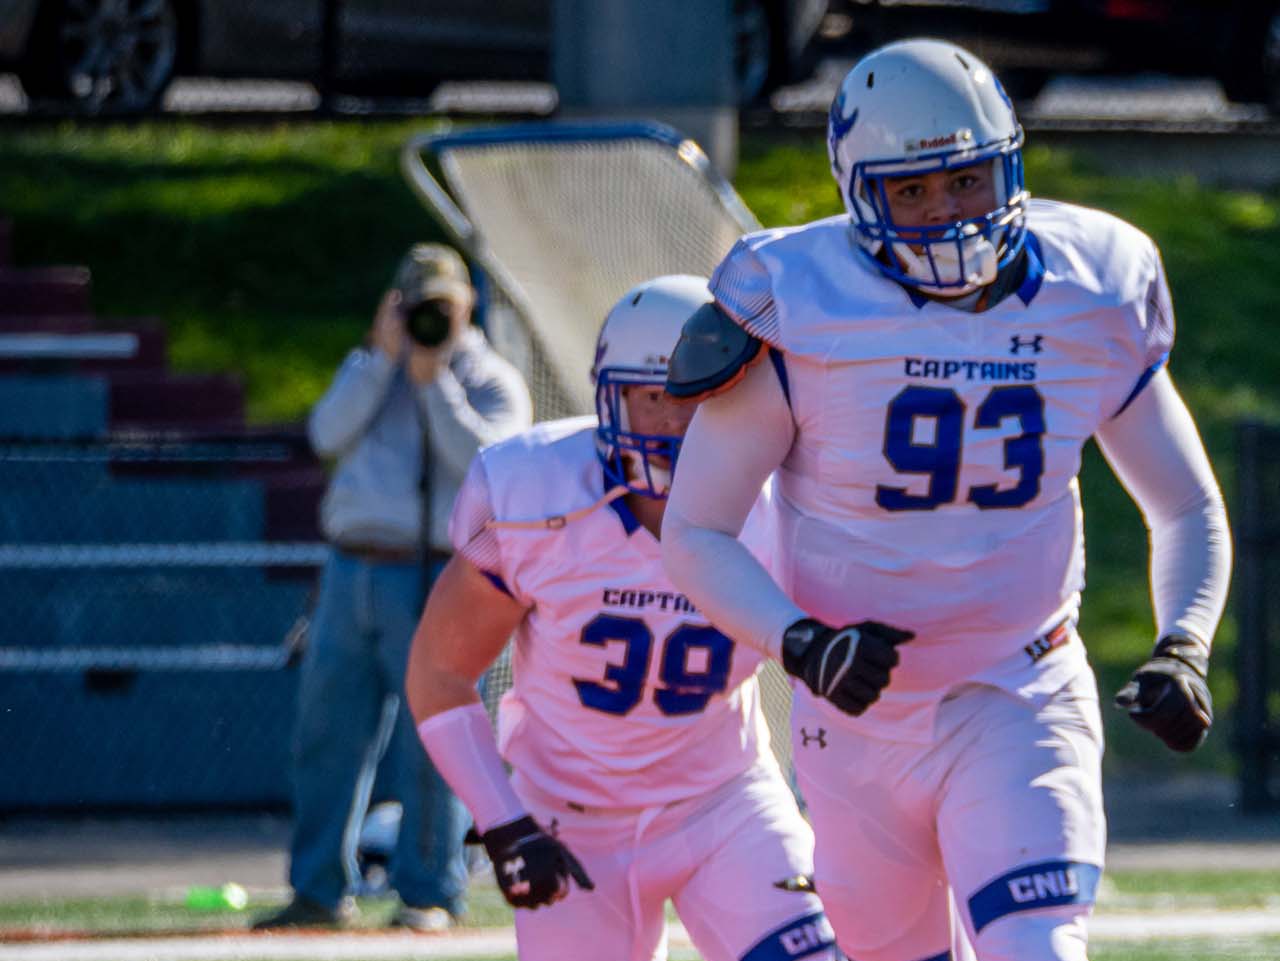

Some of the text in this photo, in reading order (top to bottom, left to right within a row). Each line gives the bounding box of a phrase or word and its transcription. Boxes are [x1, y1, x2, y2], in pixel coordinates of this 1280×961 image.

[904, 357, 1036, 381] CAPTAINS
[876, 384, 1046, 511] 93
[602, 586, 697, 613] CAPTA
[572, 612, 736, 717] 39
[1008, 870, 1078, 903] CNU
